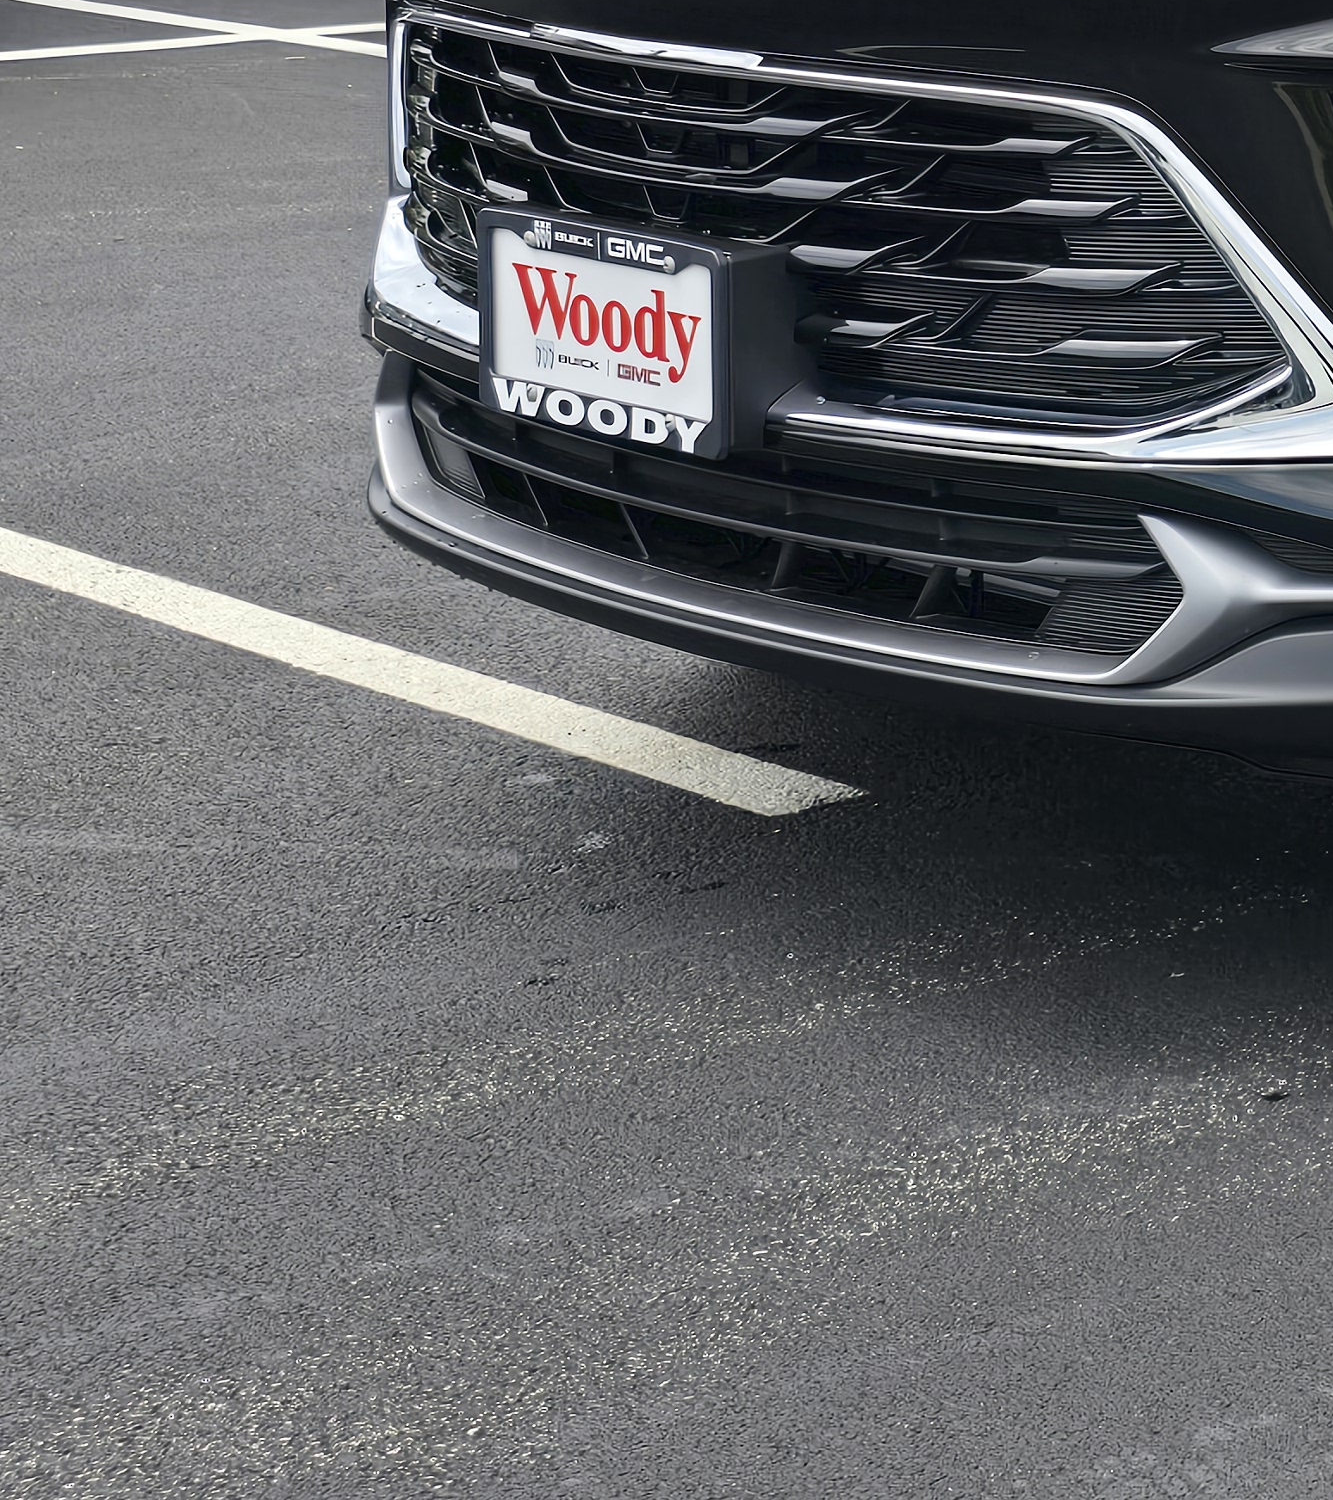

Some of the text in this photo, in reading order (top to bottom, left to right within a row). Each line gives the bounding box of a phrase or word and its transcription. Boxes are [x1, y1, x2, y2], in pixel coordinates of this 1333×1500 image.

[554, 231, 665, 266] BUICK GMC
[511, 262, 702, 384] Woody
[558, 354, 661, 387] BUICK GMC
[492, 377, 706, 454] WOODY
